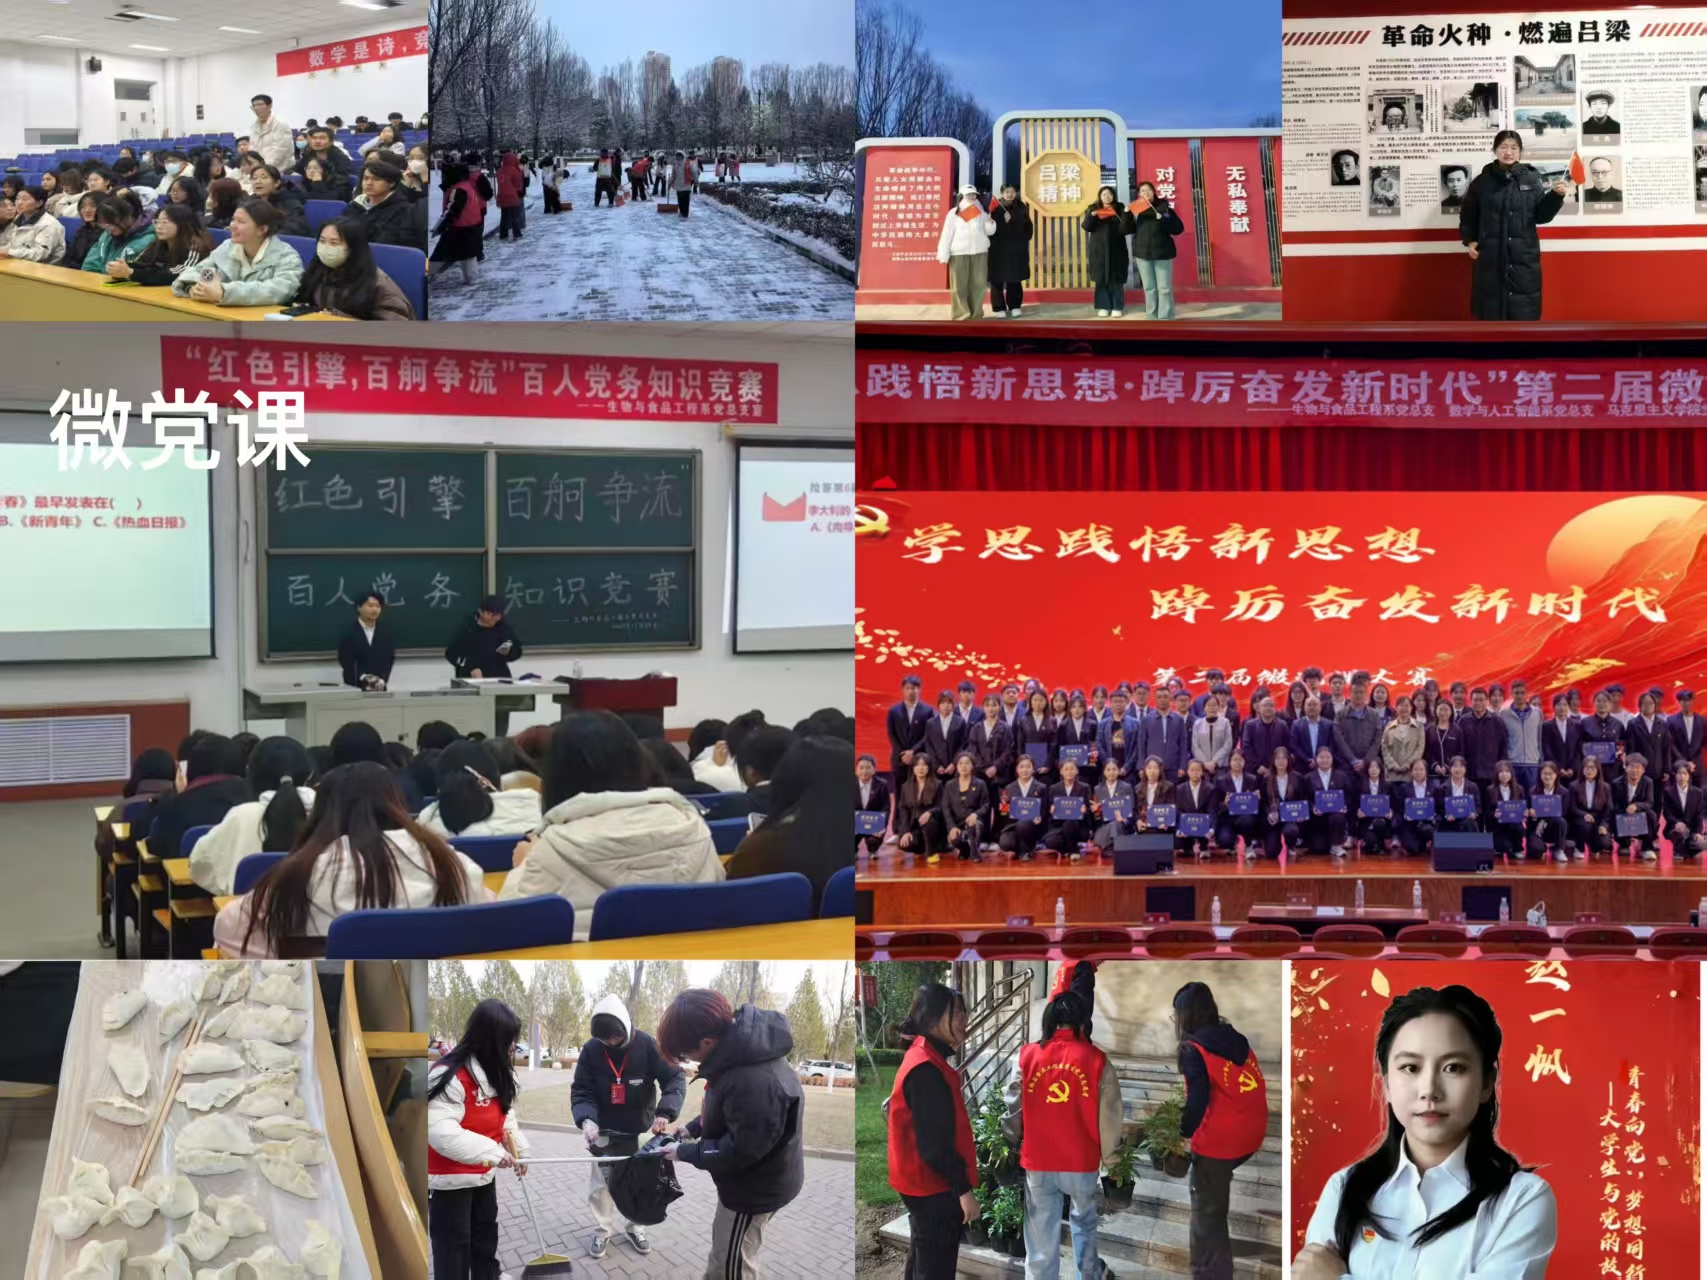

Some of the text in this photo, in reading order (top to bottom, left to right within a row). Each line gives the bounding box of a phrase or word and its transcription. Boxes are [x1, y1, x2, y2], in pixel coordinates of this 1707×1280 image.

[1382, 19, 1631, 48] 革命火种·燃遍吕梁
[1038, 184, 1081, 204] 精神
[1039, 163, 1080, 183] 吕梁
[1226, 166, 1250, 233] 无私奉献
[857, 362, 1707, 406] 践悟新思想·踔厉奋发新时代”第二届微
[274, 473, 466, 521] 红色引擎
[902, 522, 1436, 565] 学思践悟新思想
[287, 568, 678, 614] 百人党务 知识竞赛
[1149, 583, 1668, 625] 踔厉奋发新时代
[1151, 666, 1432, 687] 第二届微大赛
